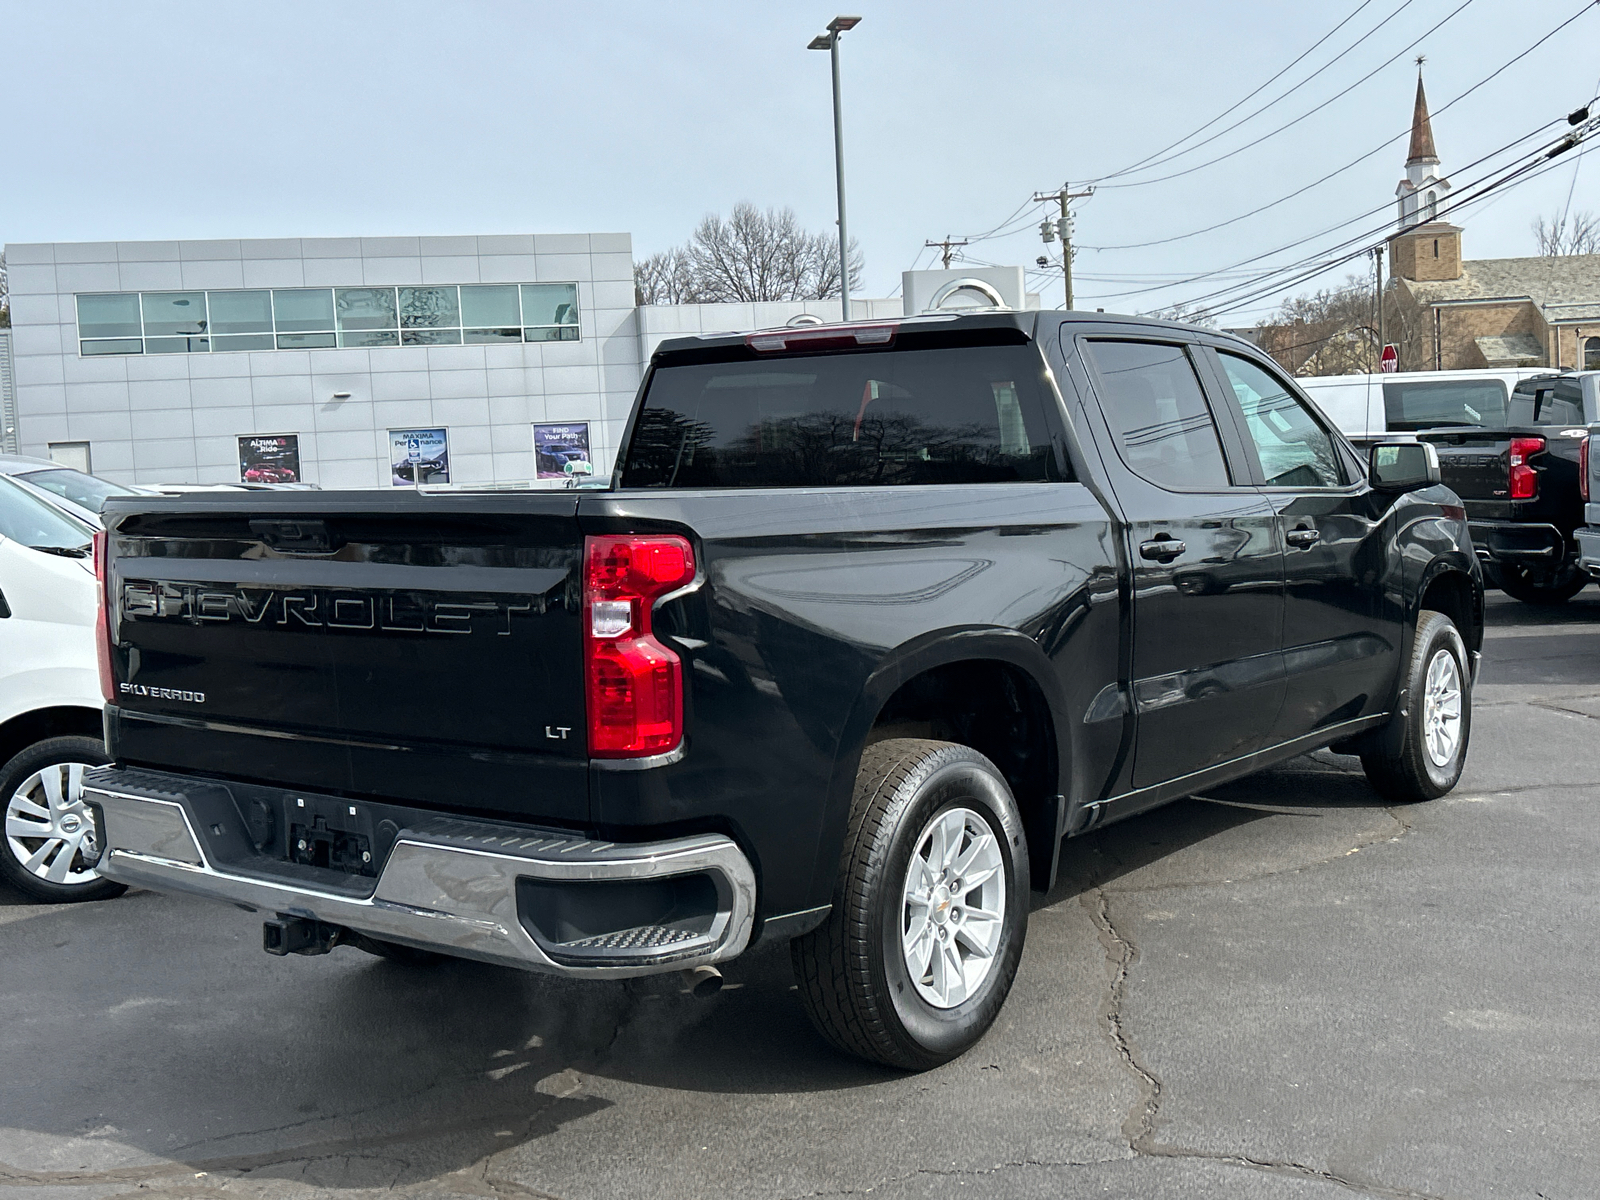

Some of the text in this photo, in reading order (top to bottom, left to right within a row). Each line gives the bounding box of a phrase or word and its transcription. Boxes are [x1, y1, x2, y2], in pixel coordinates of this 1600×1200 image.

[1382, 359, 1396, 373] STOP
[123, 584, 531, 635] CHEVROLET
[119, 682, 206, 703] SILVERADO
[545, 725, 572, 740] LT
